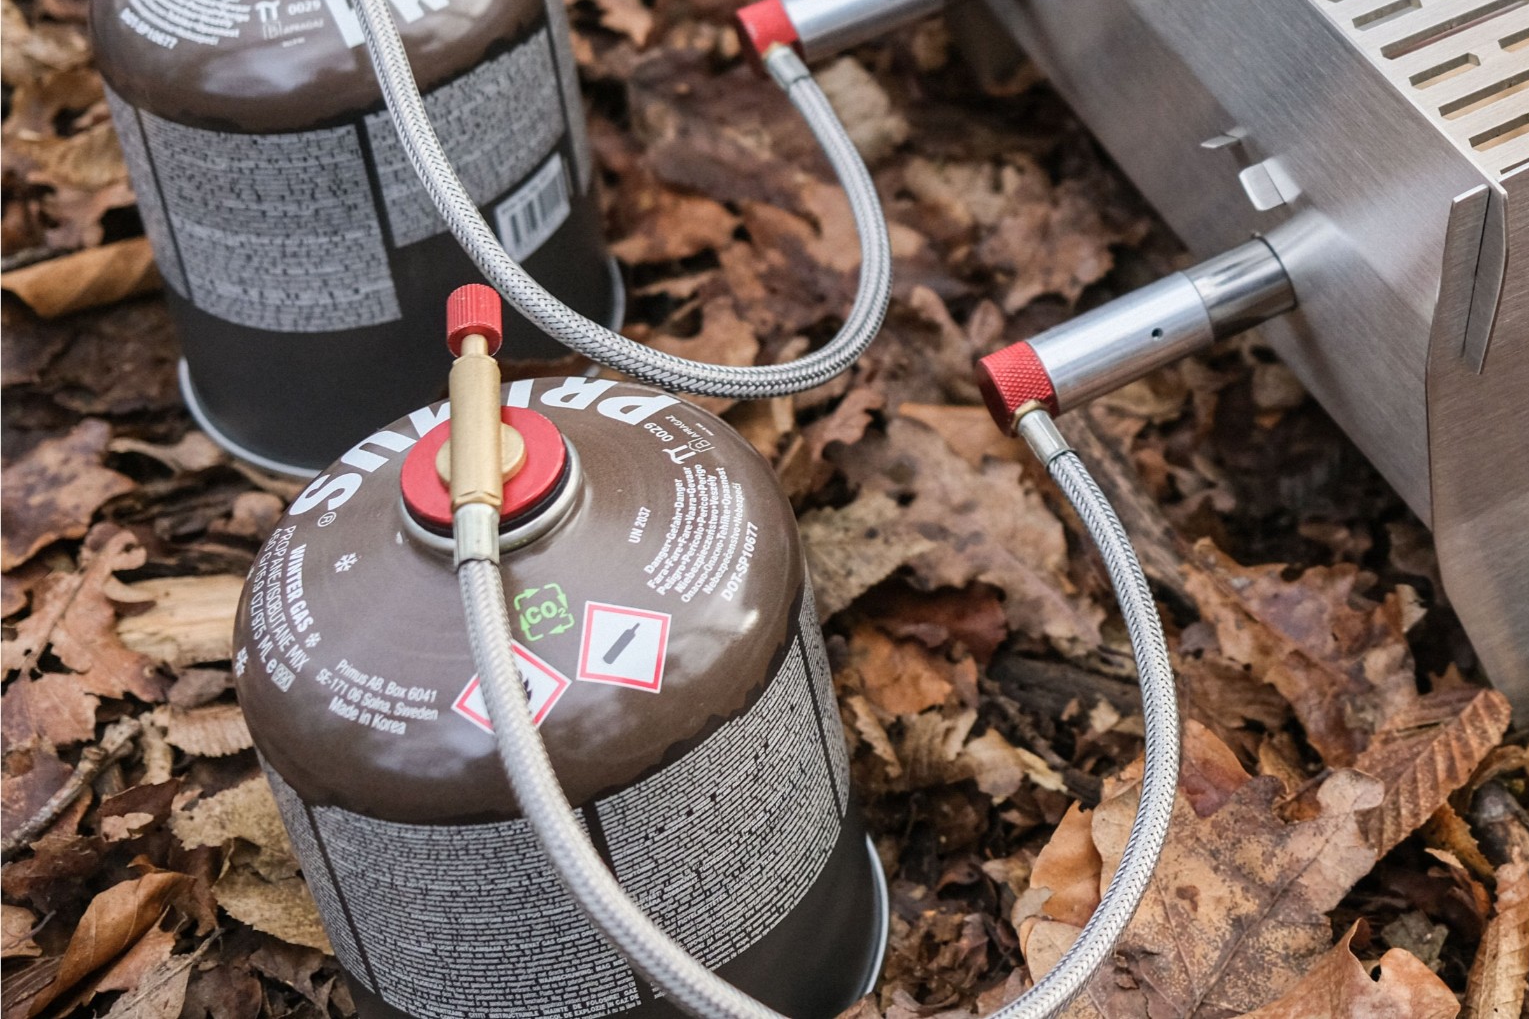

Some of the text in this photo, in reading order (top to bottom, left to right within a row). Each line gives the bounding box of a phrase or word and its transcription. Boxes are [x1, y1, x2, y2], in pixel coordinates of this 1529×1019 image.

[643, 422, 674, 442] 0029
[628, 506, 652, 544] UN 2037
[286, 543, 314, 633] WINTER GAS
[257, 634, 274, 664] ML
[285, 643, 311, 673] MIX
[315, 668, 350, 696] SE-171
[347, 687, 364, 703] 06
[393, 701, 439, 720] Sweden
[335, 658, 369, 685] Primus
[384, 681, 408, 698] Box
[407, 686, 437, 703] 6041
[328, 695, 407, 735] Made in Korea
